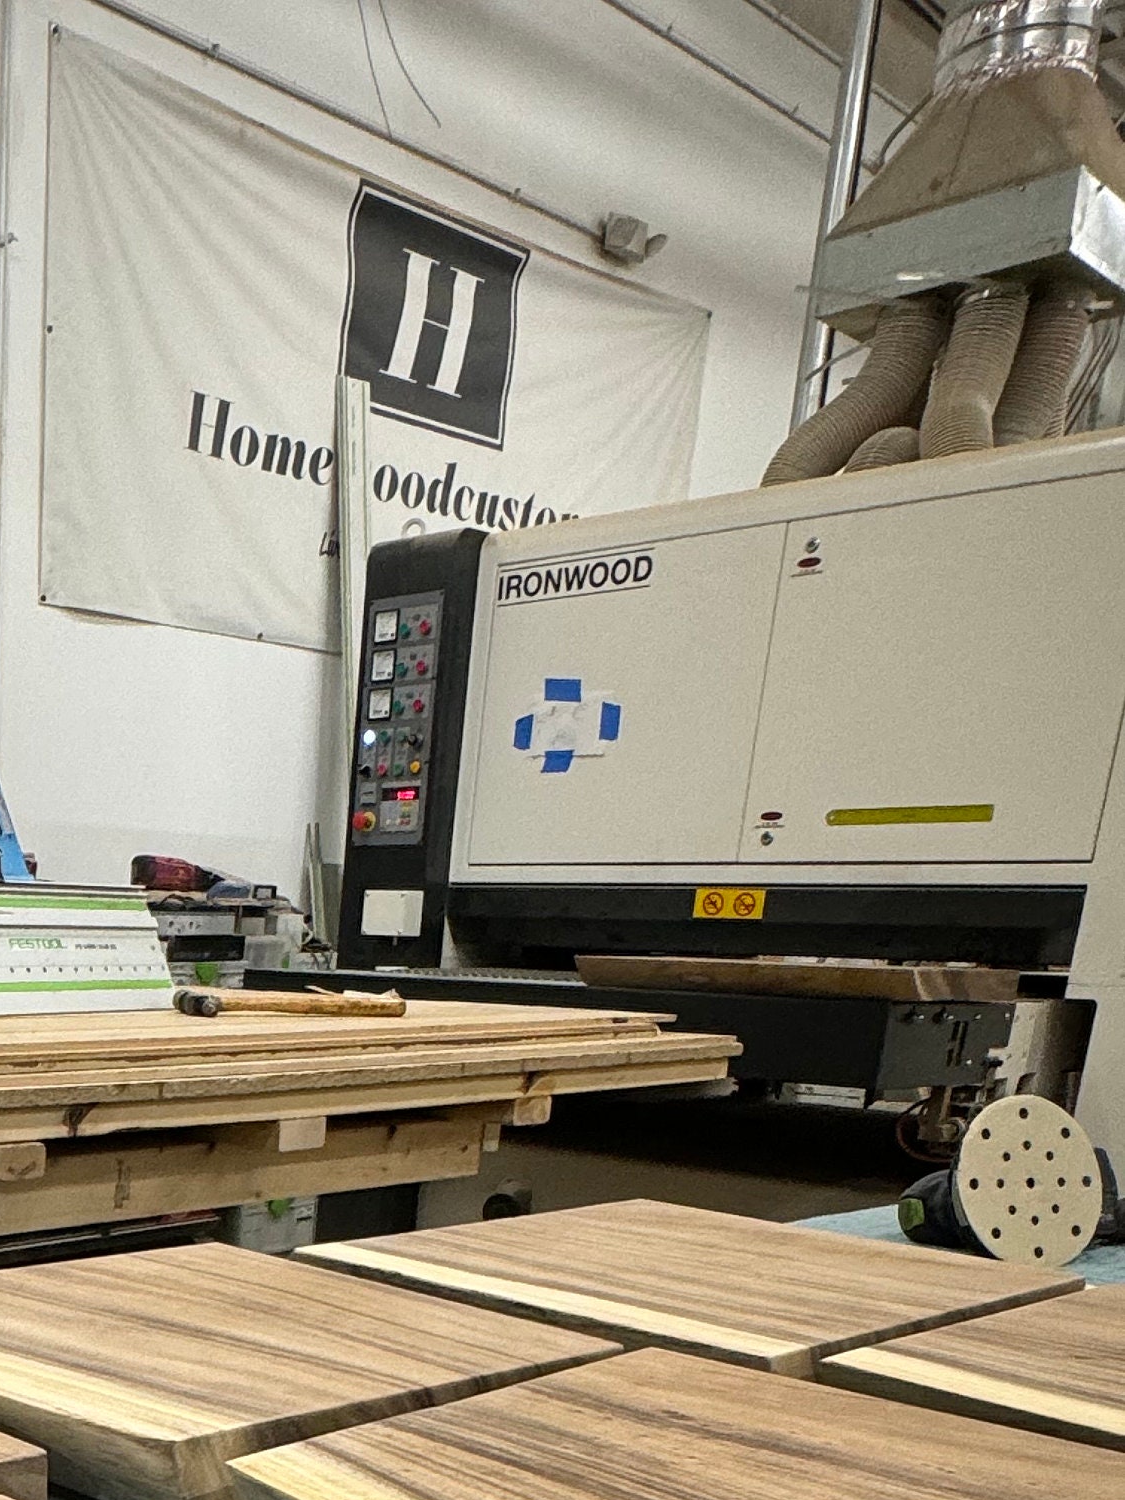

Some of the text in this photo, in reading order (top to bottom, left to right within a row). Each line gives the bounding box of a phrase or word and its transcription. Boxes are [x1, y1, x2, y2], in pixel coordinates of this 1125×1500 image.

[378, 247, 486, 398] H
[497, 555, 653, 601] IRONWOOD
[8, 937, 67, 950] FESTOOL
